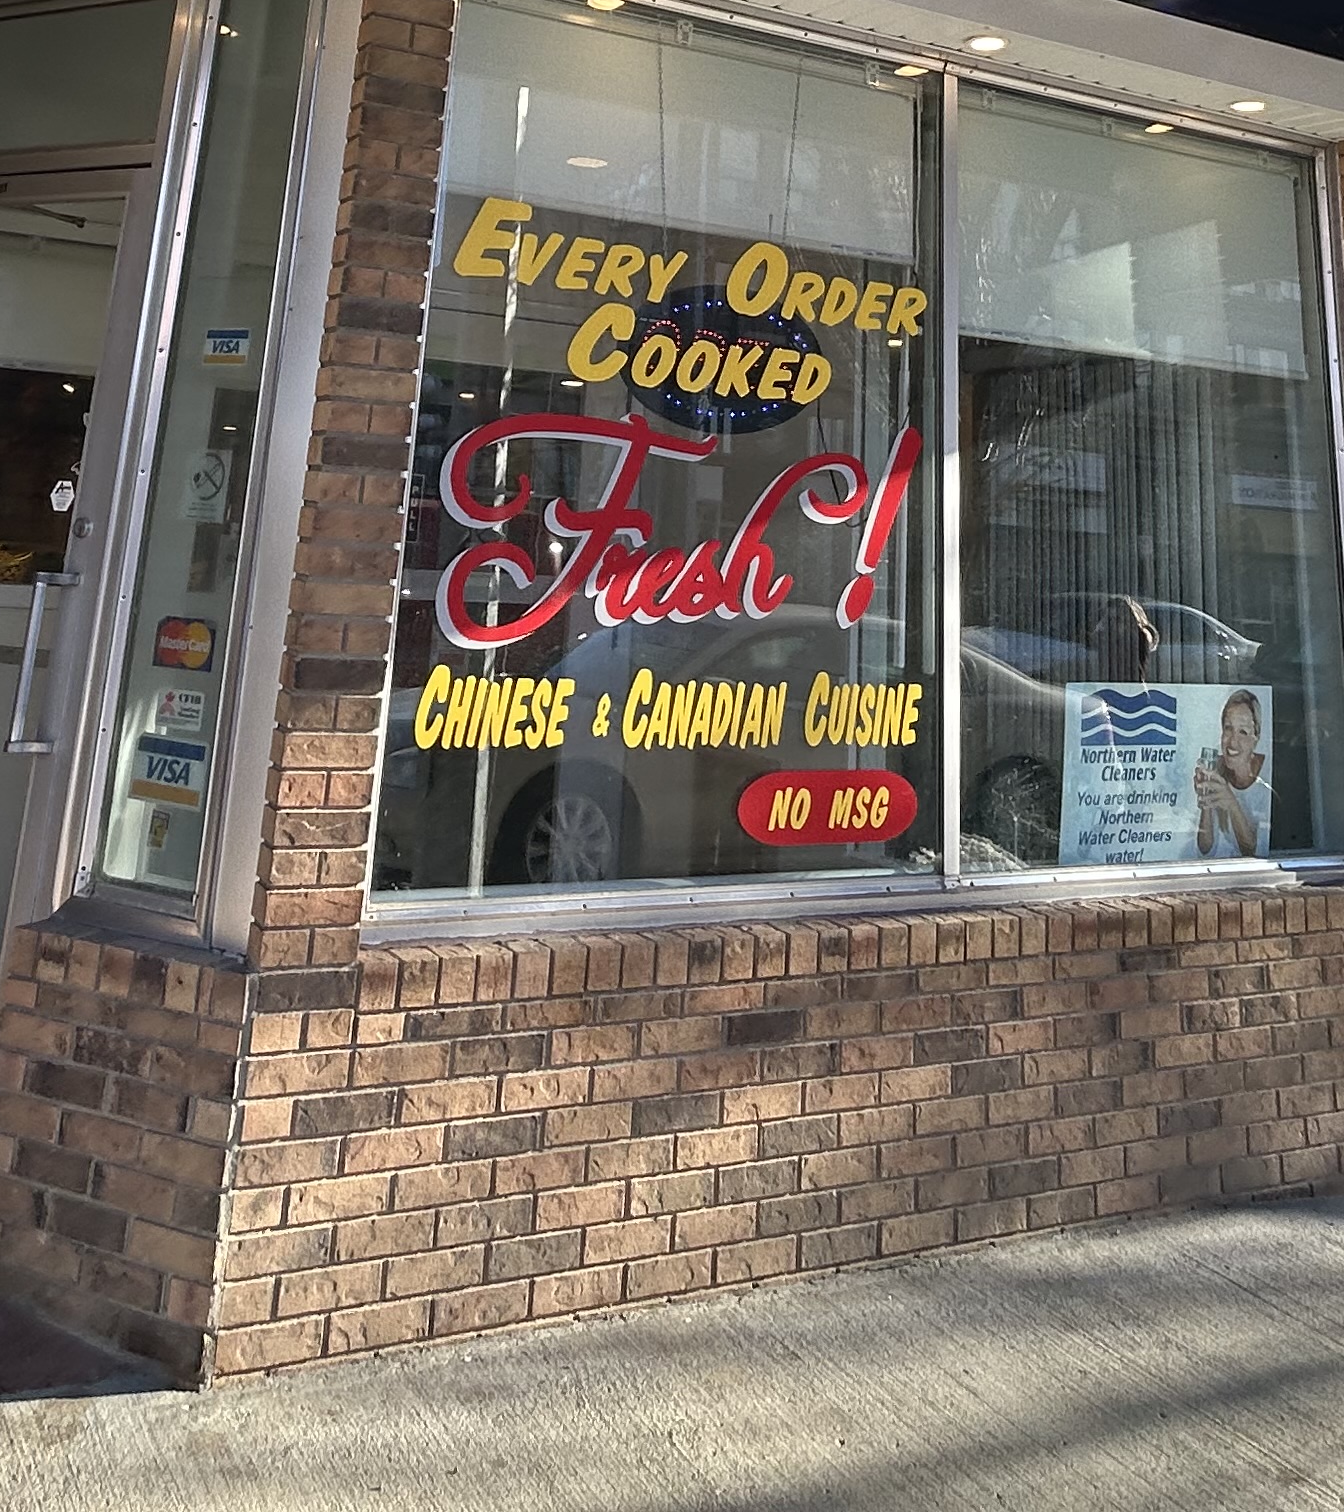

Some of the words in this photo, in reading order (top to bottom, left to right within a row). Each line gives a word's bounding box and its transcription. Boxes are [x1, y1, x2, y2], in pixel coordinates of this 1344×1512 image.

[453, 197, 688, 302] EVERY
[726, 242, 927, 337] ORDER
[210, 338, 241, 356] VISA
[567, 302, 833, 406] COOKED
[159, 633, 212, 656] MasterCard
[414, 664, 576, 750] CHINESE
[592, 693, 612, 738] &
[622, 668, 788, 750] CANADIAN
[805, 671, 923, 747] CUISINE
[1080, 747, 1137, 764] Northern
[1140, 748, 1177, 763] Water
[145, 753, 192, 788] VISA
[1101, 766, 1157, 782] Cleaners
[1077, 791, 1101, 806] You
[1104, 794, 1124, 806] are
[1127, 790, 1178, 807] drinking
[768, 787, 812, 832] NO
[828, 786, 892, 829] MSG
[1099, 810, 1154, 825] Northern
[1078, 831, 1114, 845] Water
[1118, 829, 1173, 844] Cleaners
[1105, 848, 1144, 864] water!
